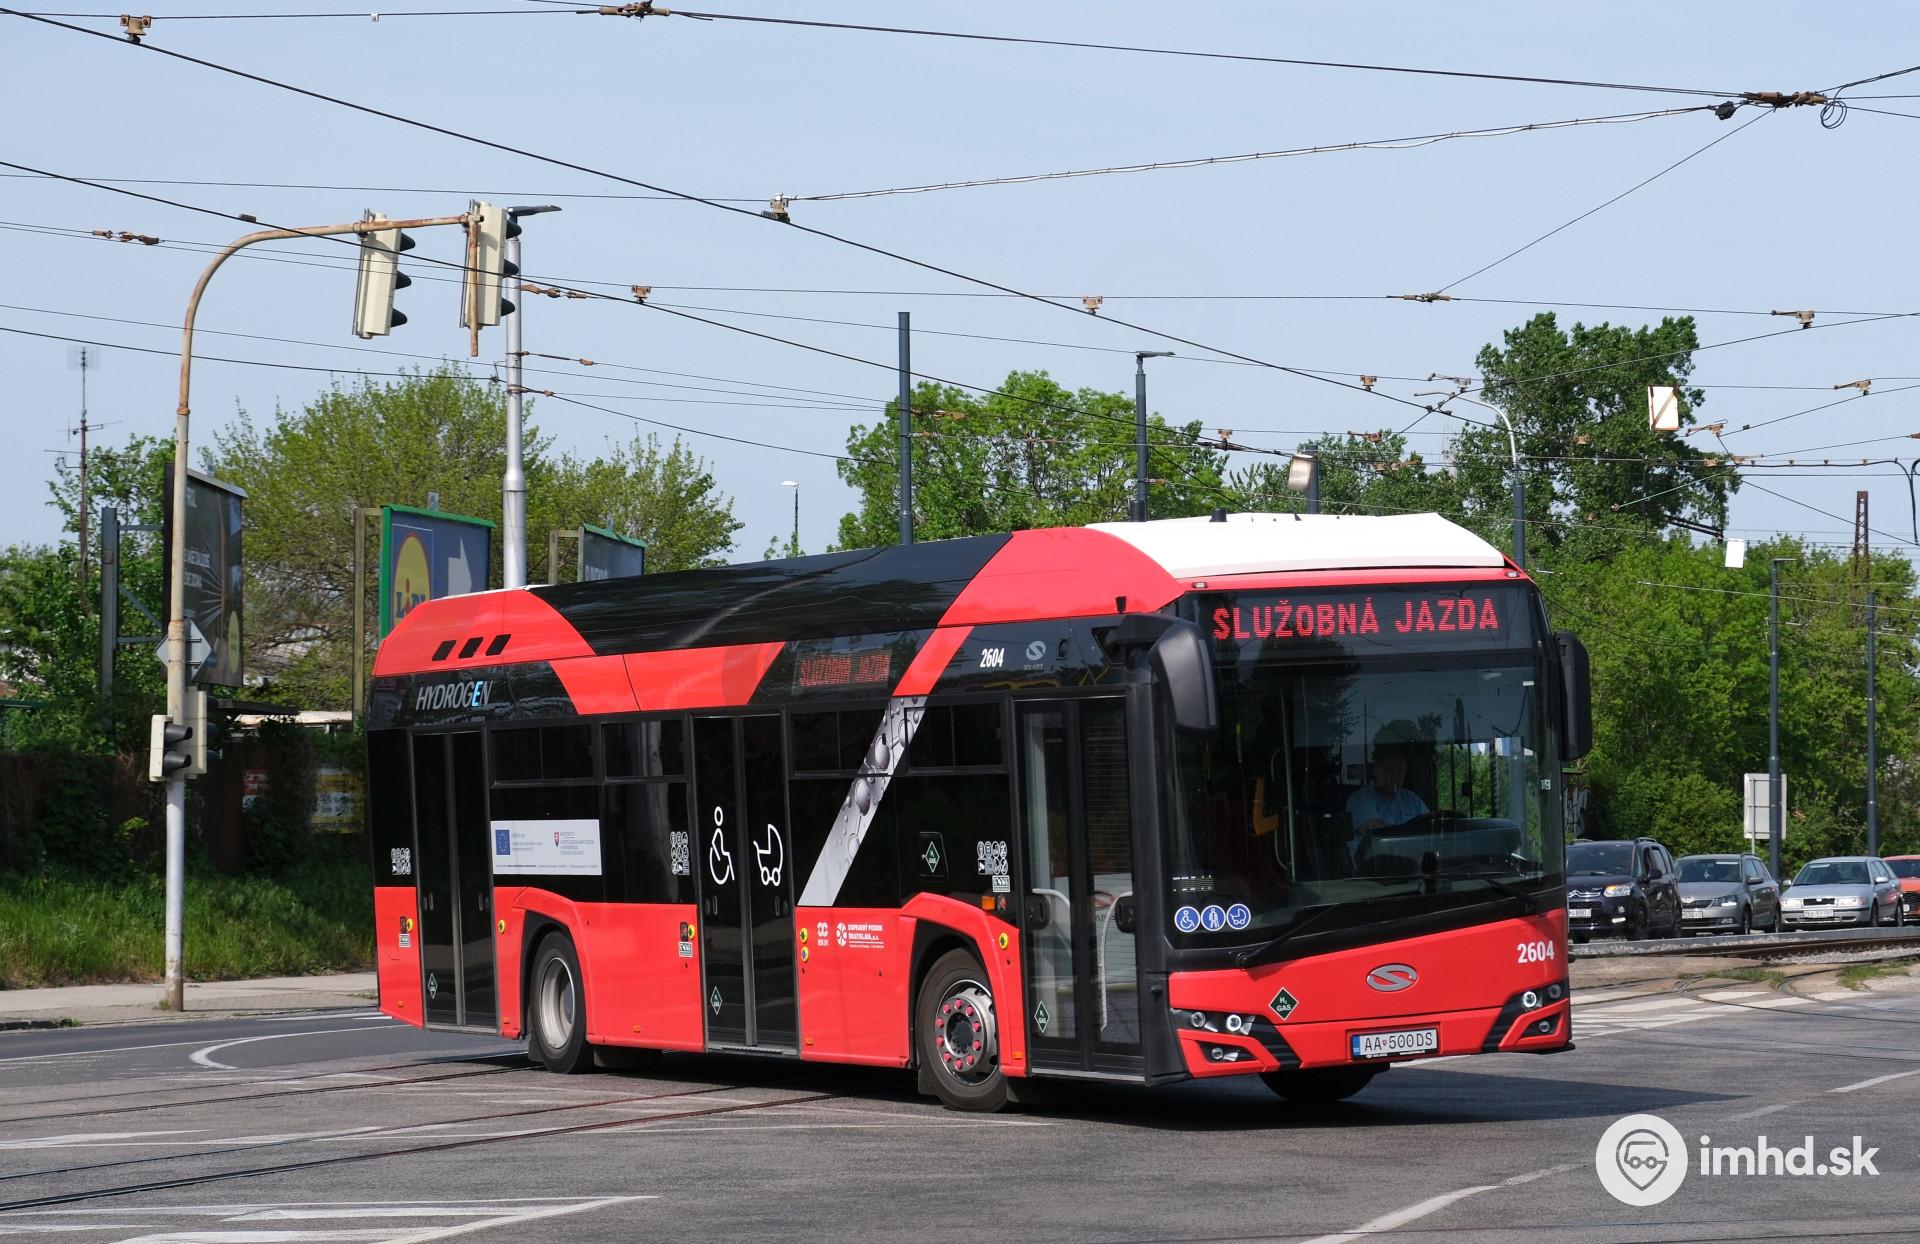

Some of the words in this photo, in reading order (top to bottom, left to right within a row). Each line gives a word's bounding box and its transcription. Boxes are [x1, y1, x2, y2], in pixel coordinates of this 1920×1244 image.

[1213, 597, 1380, 641] SLUŽOBNÁ
[1395, 598, 1499, 634] JAZDA
[979, 648, 1005, 668] 2604
[415, 680, 493, 711] HYDROGEN
[1516, 940, 1555, 964] 2604
[1276, 1004, 1292, 1012] GAS
